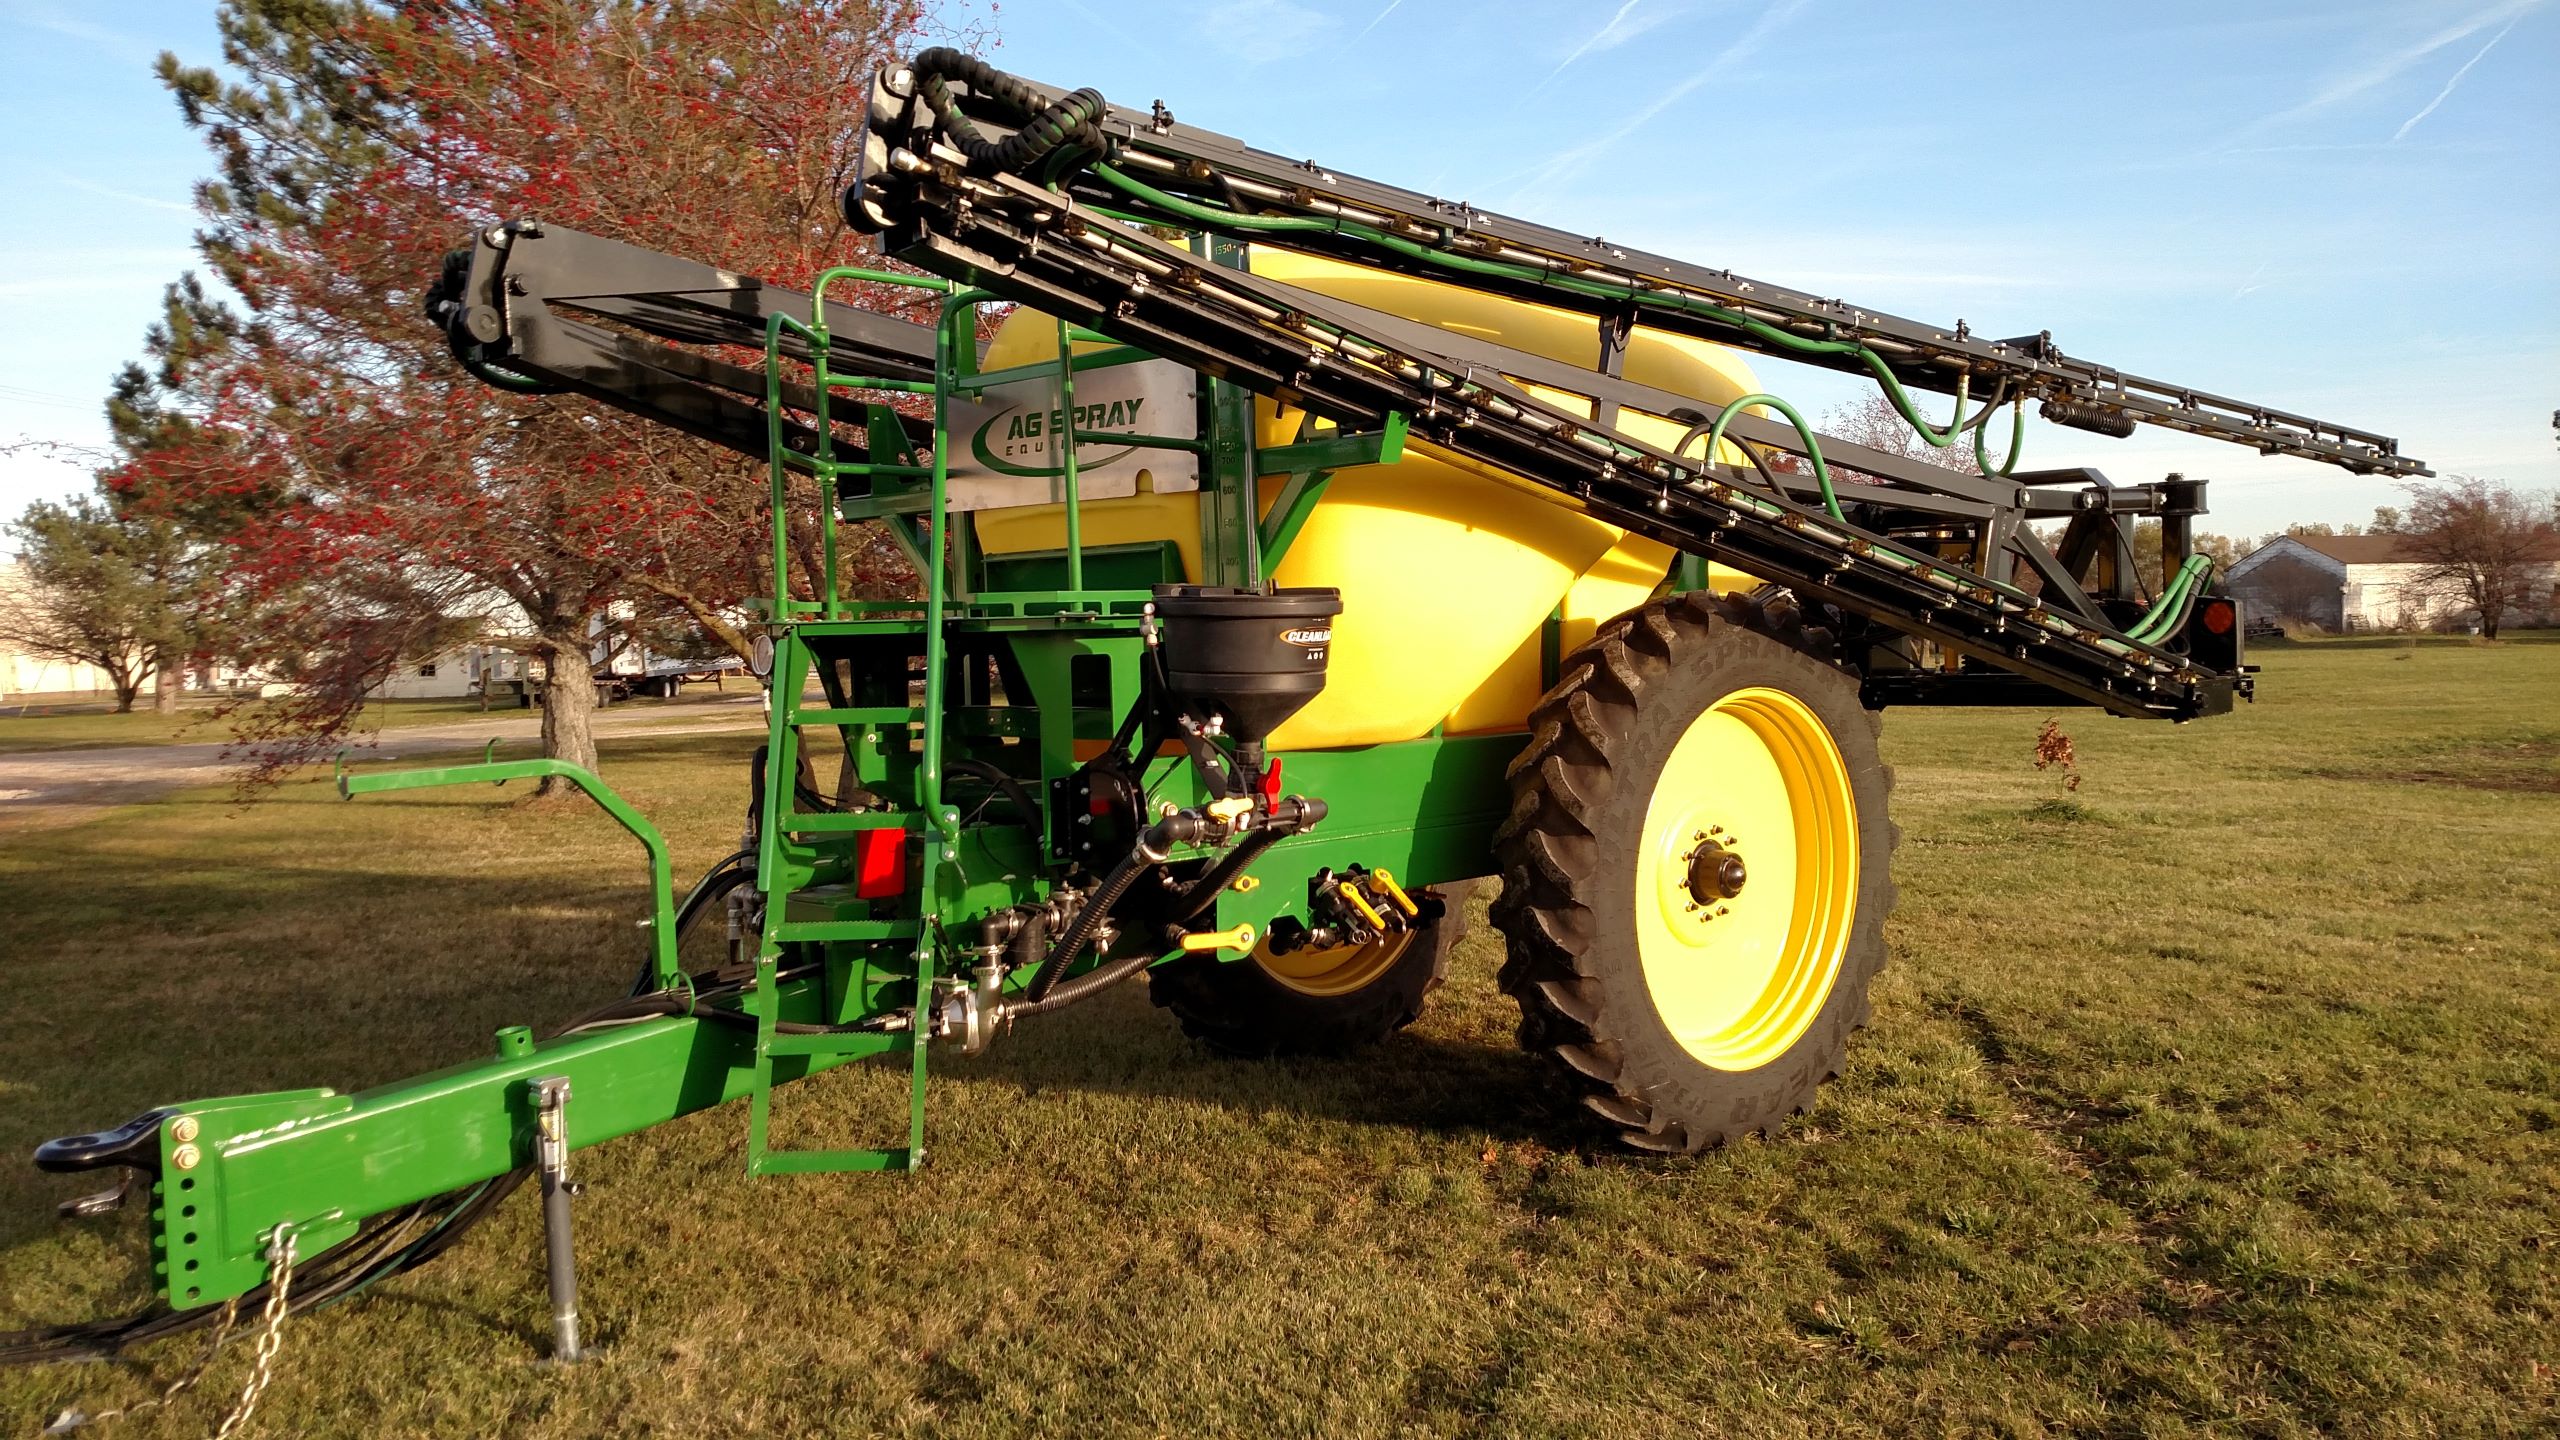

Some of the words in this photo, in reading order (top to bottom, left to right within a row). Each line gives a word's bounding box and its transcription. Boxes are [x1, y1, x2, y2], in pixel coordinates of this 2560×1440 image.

[1007, 412, 1042, 440] AG
[1050, 398, 1144, 434] SPRAY
[1221, 456, 1236, 465] 700
[1223, 486, 1237, 495] 600
[1287, 630, 1332, 642] CLEANLO
